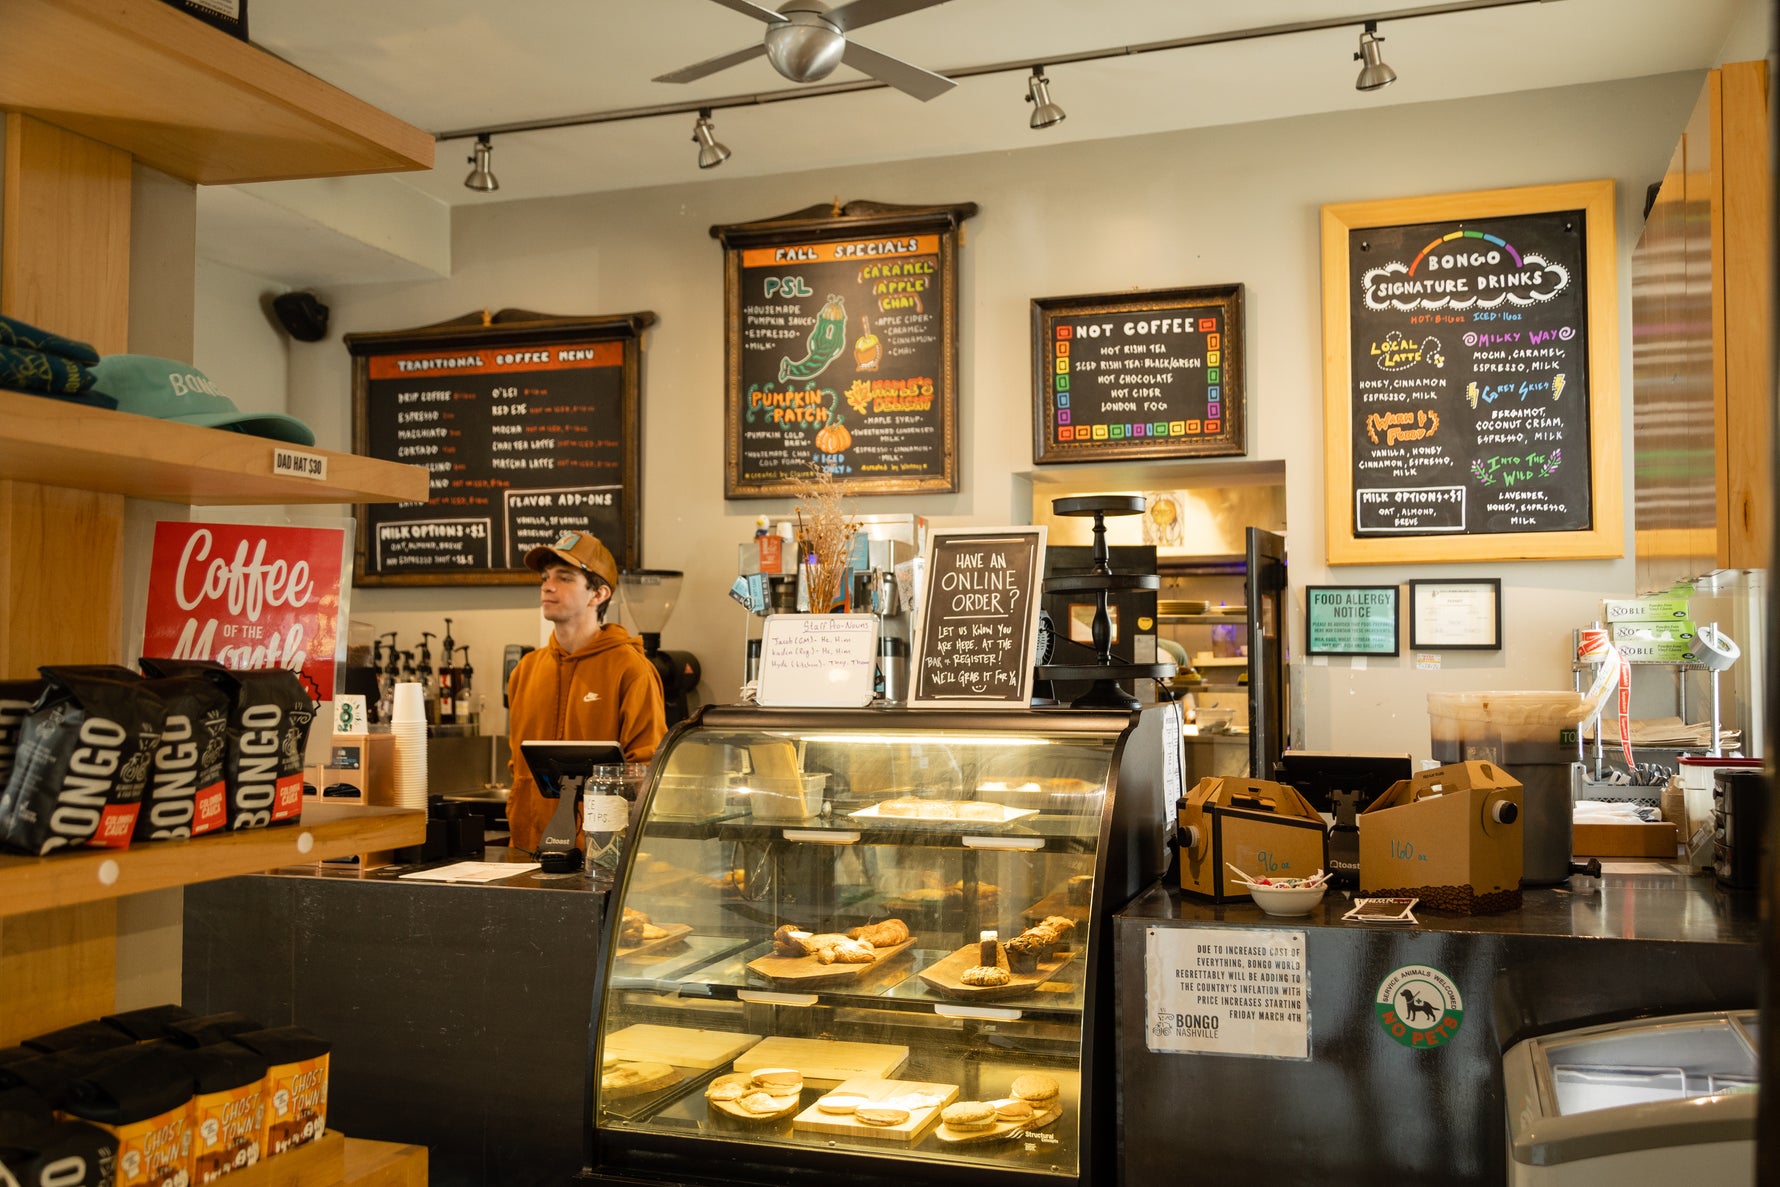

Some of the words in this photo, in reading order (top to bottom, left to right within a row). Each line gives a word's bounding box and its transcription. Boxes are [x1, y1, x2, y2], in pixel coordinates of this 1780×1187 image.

[776, 248, 818, 262] FALL
[834, 240, 918, 258] SPECIALS
[1428, 250, 1501, 271] BONGO
[863, 262, 934, 279] CARAMEL
[764, 276, 813, 298] PSL
[877, 278, 925, 294] APPLE
[1378, 278, 1468, 298] SIGNATURE
[1477, 270, 1542, 290] DRINKS
[748, 304, 801, 314] HOUSEMADE
[882, 295, 914, 310] CHAI
[748, 316, 785, 326] PUMPKIN
[788, 316, 812, 326] SAUCE
[878, 316, 902, 326] APPLE
[904, 314, 929, 324] CIDER
[1502, 312, 1522, 321] 16oz
[749, 329, 796, 338] ESPRESSO
[888, 325, 924, 336] CARAMEL
[1076, 324, 1114, 338] NOT
[1124, 318, 1194, 336] COFFEE
[750, 342, 772, 350] MILK
[1370, 338, 1418, 355] LOCAL
[1478, 332, 1520, 348] MILKY
[1528, 330, 1558, 346] WAY
[1100, 346, 1120, 356] HOT
[1124, 344, 1146, 354] RISHI
[1150, 344, 1166, 353] TEA
[397, 355, 484, 372] TRADITIONAL
[496, 351, 550, 364] COFFEE
[558, 349, 594, 362] MENU
[1075, 361, 1096, 372] ICED
[1100, 360, 1122, 370] RISHI
[1384, 352, 1422, 366] LATTE
[1531, 360, 1560, 371] MILK
[1098, 374, 1115, 384] HOT
[1119, 373, 1173, 384] CHOCOLATE
[1393, 378, 1446, 388] CINNAMON
[420, 390, 452, 402] COFFEE
[752, 389, 822, 408] PUMPKIN
[1110, 388, 1129, 398] HOT
[1132, 388, 1162, 398] CIDER
[1412, 391, 1438, 400] MILK
[1482, 384, 1515, 404] GREY
[492, 405, 510, 416] RED
[773, 406, 827, 423] PATCH
[1101, 402, 1136, 412] LONDON
[1144, 402, 1168, 411] FOG
[1476, 420, 1522, 431] COCONUT
[1534, 432, 1563, 441] MILK
[1412, 446, 1442, 455] HONEY
[277, 454, 292, 470] DAD
[293, 457, 308, 472] HAT
[308, 459, 322, 476] $30
[1488, 456, 1520, 474] INTO
[1526, 452, 1546, 466] THE
[1392, 468, 1417, 477] MILK
[1503, 470, 1534, 488] WILD
[509, 494, 552, 508] FLAVOR
[558, 493, 612, 507] ADD-ONS
[1362, 492, 1389, 504] MILK
[1394, 518, 1418, 526] BREVE
[1510, 516, 1536, 526] MILK
[380, 525, 412, 540] MILK
[413, 524, 464, 539] OPTIONS
[956, 553, 984, 569] HAVE
[990, 552, 1006, 568] AN
[175, 528, 314, 622] Coffee
[942, 570, 1018, 591] ONLINE
[1314, 594, 1342, 605] FOOD
[1346, 594, 1391, 605] ALLERGY
[1334, 606, 1371, 618] NOTICE
[1612, 607, 1646, 616] NOBLE
[224, 624, 238, 638] OF
[242, 625, 263, 639] THE
[938, 626, 954, 639] LET
[958, 626, 968, 636] US
[972, 624, 993, 637] KNOW
[998, 624, 1012, 635] YOU
[937, 641, 952, 656] ARE
[982, 638, 993, 652] AT
[996, 638, 1012, 650] THE
[1620, 647, 1654, 656] NOBLE
[926, 656, 942, 668] BAR
[953, 651, 1002, 667] REGISTER!
[932, 670, 956, 685] WE'LL
[958, 670, 980, 687] GRAB
[983, 672, 993, 682] IT
[994, 670, 1008, 684] FOR
[340, 702, 352, 724] 8
[1391, 840, 1414, 860] 160
[1258, 850, 1278, 872] 96
[1338, 860, 1360, 870] toast
[1197, 945, 1211, 954] DUE
[1214, 946, 1223, 954] TO
[1226, 946, 1266, 956] INCREASED
[1270, 948, 1288, 957] COST
[1290, 949, 1300, 957] OF
[1197, 958, 1244, 969] EVERYTHING,
[1248, 960, 1272, 969] BONGO
[1275, 961, 1300, 970] WORLD
[1176, 970, 1225, 980] REGRETTABLY
[1228, 972, 1246, 981] WILL
[1249, 973, 1258, 982] BE
[1260, 974, 1288, 982] ADDING
[1292, 974, 1300, 984] TO
[1181, 982, 1194, 992] THE
[1196, 983, 1237, 993] COUNTRY'S
[1240, 985, 1278, 994] INFLATION
[1282, 987, 1300, 996] WITH
[1382, 976, 1400, 1002] SERVICE
[1401, 970, 1432, 978] ANIMALS
[1434, 974, 1457, 1010] WELCOMED
[1197, 996, 1218, 1006] PRICE
[1222, 998, 1262, 1008] INCREASES
[1264, 999, 1301, 1010] STARTING
[1176, 1014, 1219, 1030] BONGO
[1230, 1010, 1256, 1020] FRIDAY
[1258, 1011, 1284, 1021] MARCH
[1287, 1012, 1302, 1022] 4TH
[1176, 1028, 1219, 1039] NASHVILLE
[1381, 1010, 1406, 1037] NO
[1412, 1016, 1458, 1046] PETS
[292, 1067, 324, 1096] GHOST
[292, 1090, 318, 1112] TOWN
[222, 1093, 260, 1125] GHOST
[144, 1120, 184, 1155] GHOST
[222, 1118, 255, 1143] TOWN
[145, 1144, 180, 1174] TOWN
